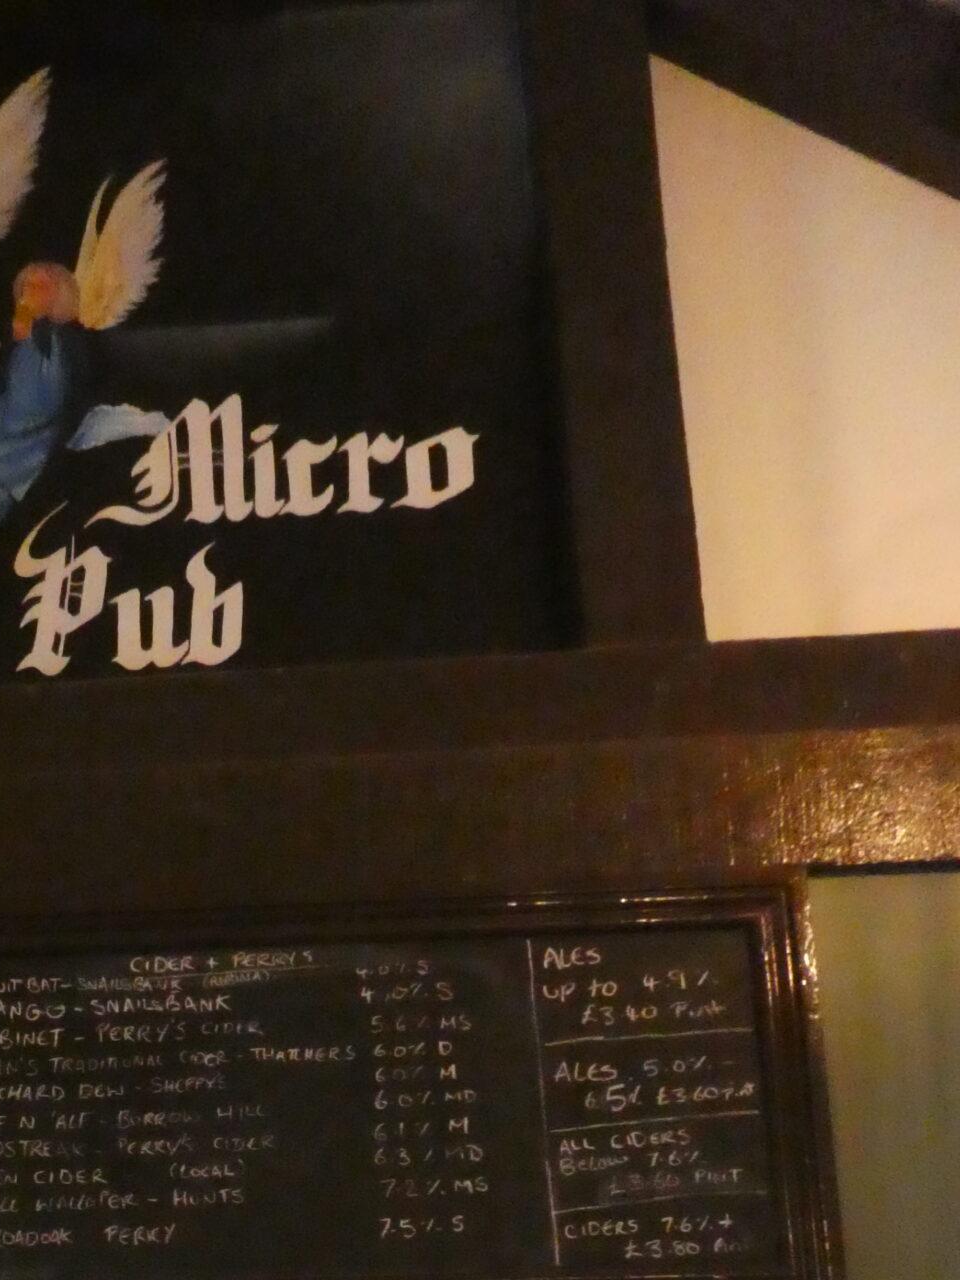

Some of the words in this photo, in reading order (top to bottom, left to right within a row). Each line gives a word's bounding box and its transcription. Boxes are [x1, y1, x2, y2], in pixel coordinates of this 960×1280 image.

[84, 393, 480, 525] Micro
[14, 501, 244, 677] Pub
[130, 957, 195, 974] CIDER
[543, 946, 602, 970] ALES
[436, 982, 454, 1001] S
[438, 1040, 453, 1056] D
[79, 1082, 124, 1099] DEW
[440, 1063, 457, 1080] M
[553, 1060, 619, 1083] ALES
[448, 1116, 469, 1135] M
[559, 1138, 596, 1156] ALL
[609, 1129, 691, 1150] CIDERS
[33, 1167, 109, 1185] CIDER
[453, 1178, 489, 1195] MS
[451, 1215, 464, 1232] S
[564, 1219, 639, 1240] CIDERS
